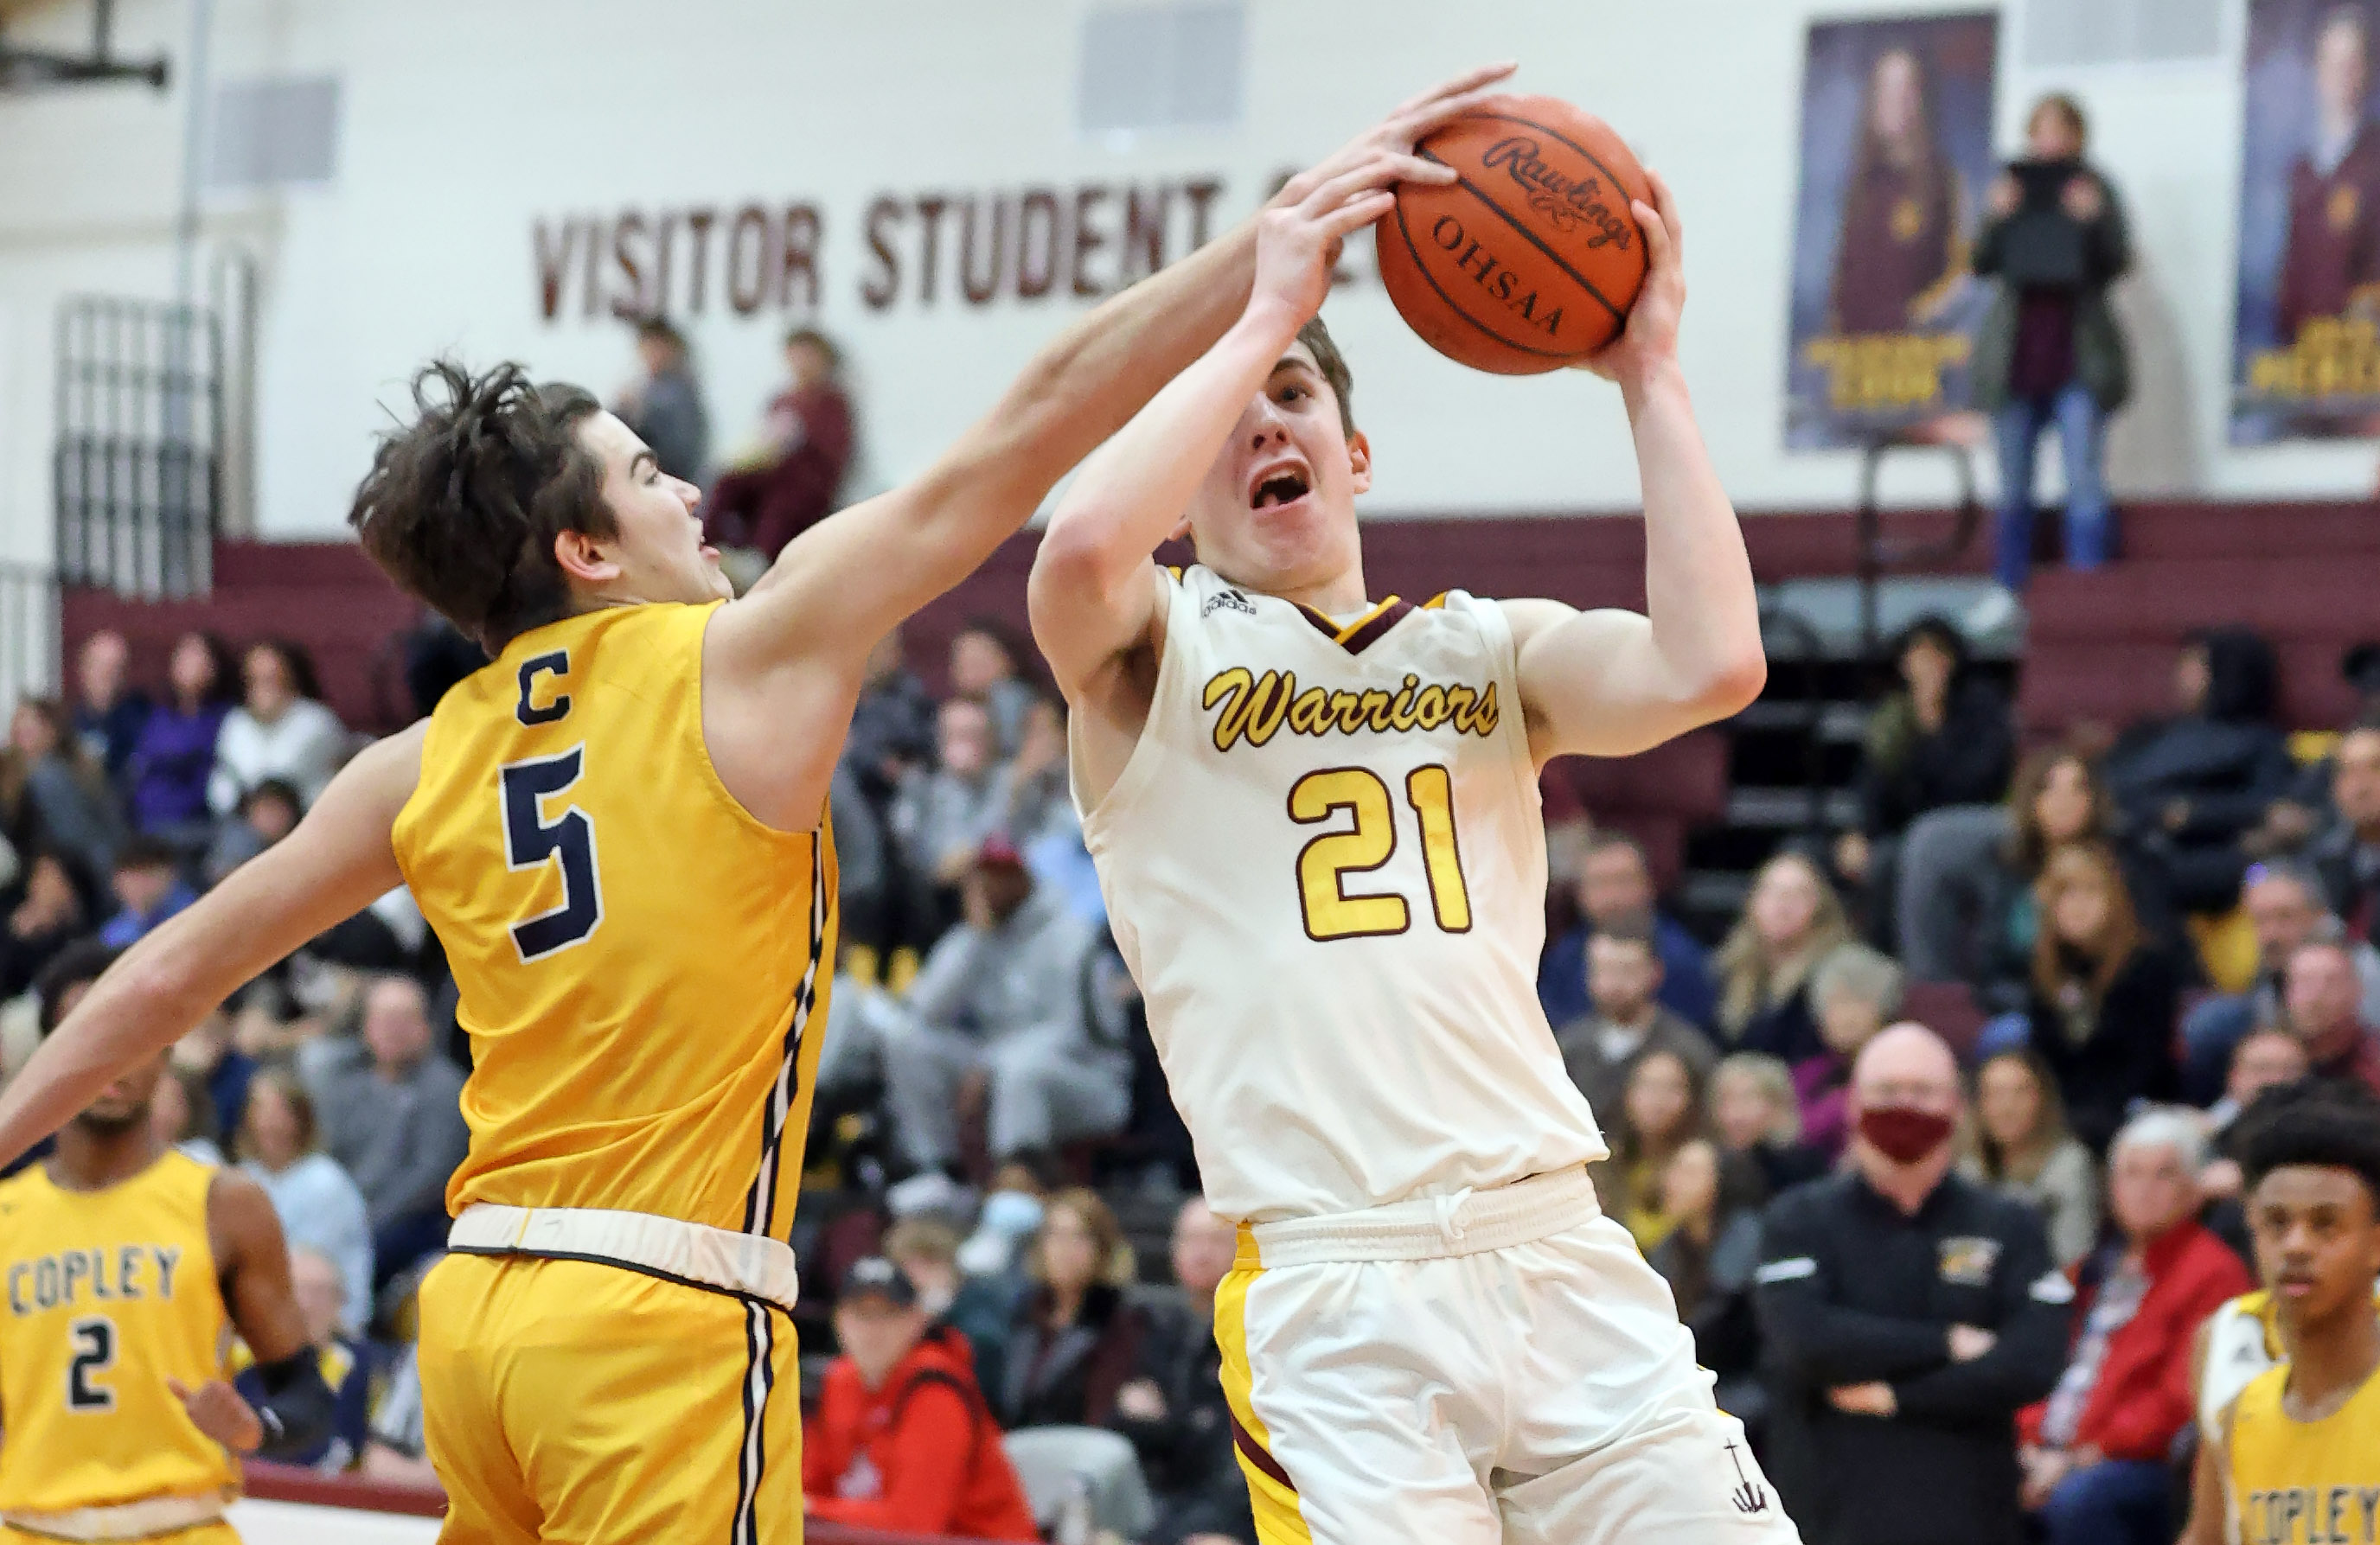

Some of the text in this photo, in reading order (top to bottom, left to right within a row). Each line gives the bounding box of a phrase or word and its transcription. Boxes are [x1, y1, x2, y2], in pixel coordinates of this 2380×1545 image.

[1481, 136, 1632, 251] Rawlings
[532, 201, 823, 321] VISITOR
[861, 179, 1225, 309] STUDENT
[1431, 214, 1564, 335] OHSAA
[1202, 595, 1257, 619] adidas
[516, 648, 571, 729] C
[1202, 667, 1500, 752] Warriors
[496, 740, 604, 965] 5
[1287, 763, 1472, 942] 21
[8, 1245, 182, 1318] COPLEY
[69, 1313, 117, 1414] 2
